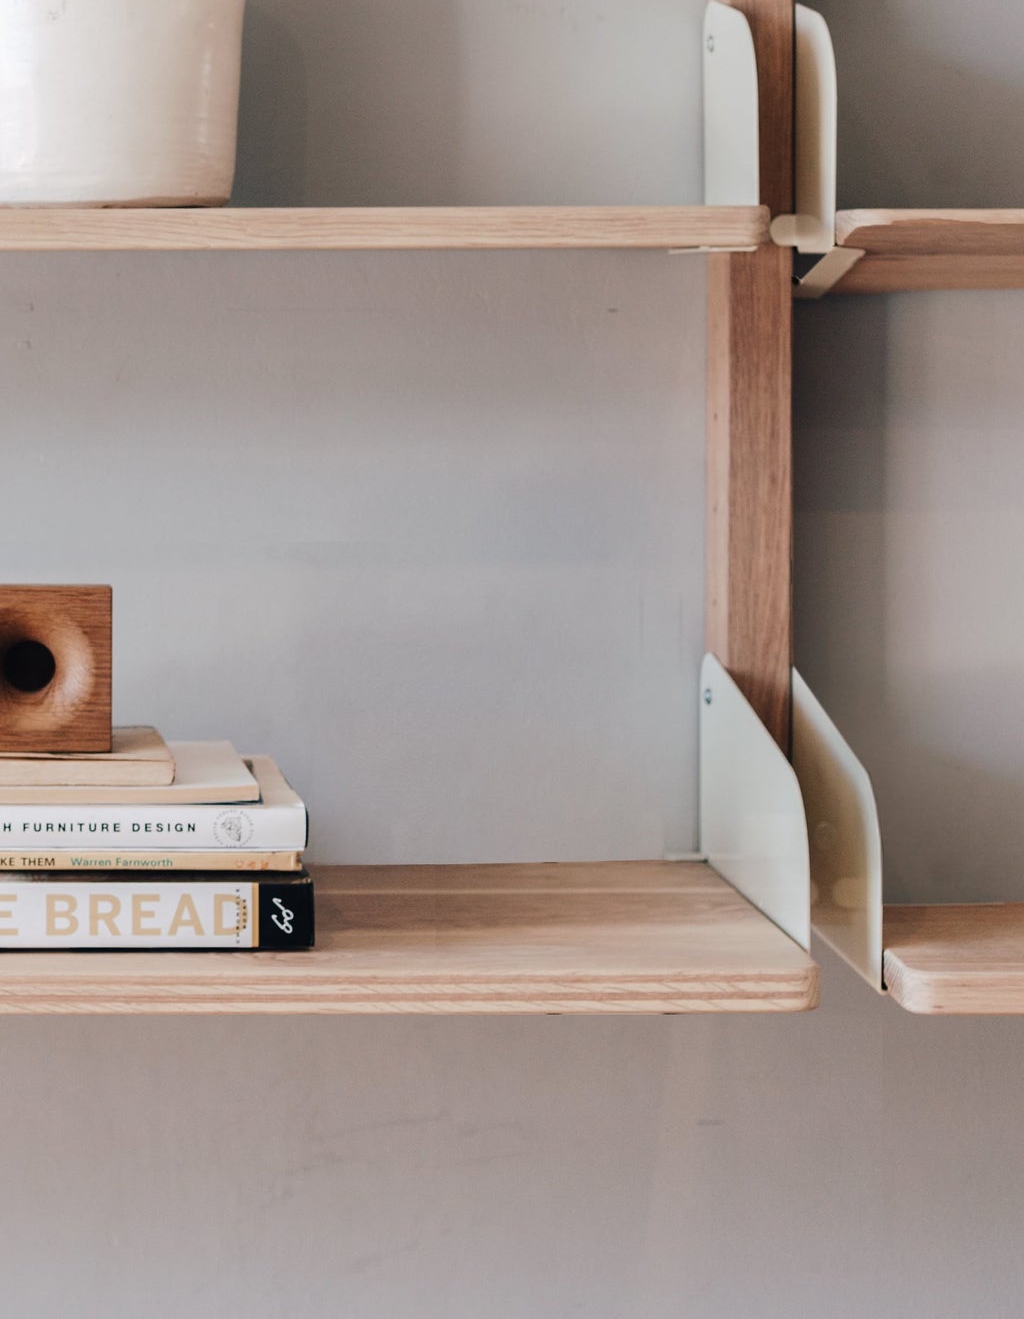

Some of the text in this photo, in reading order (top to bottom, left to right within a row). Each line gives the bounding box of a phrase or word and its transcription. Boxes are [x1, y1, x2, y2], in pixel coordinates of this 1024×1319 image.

[22, 822, 121, 833] FURNITURE
[131, 822, 197, 833] DESIGN
[21, 857, 56, 867] THEM
[70, 857, 174, 867] Warren Farnworth
[45, 893, 247, 937] BREAD
